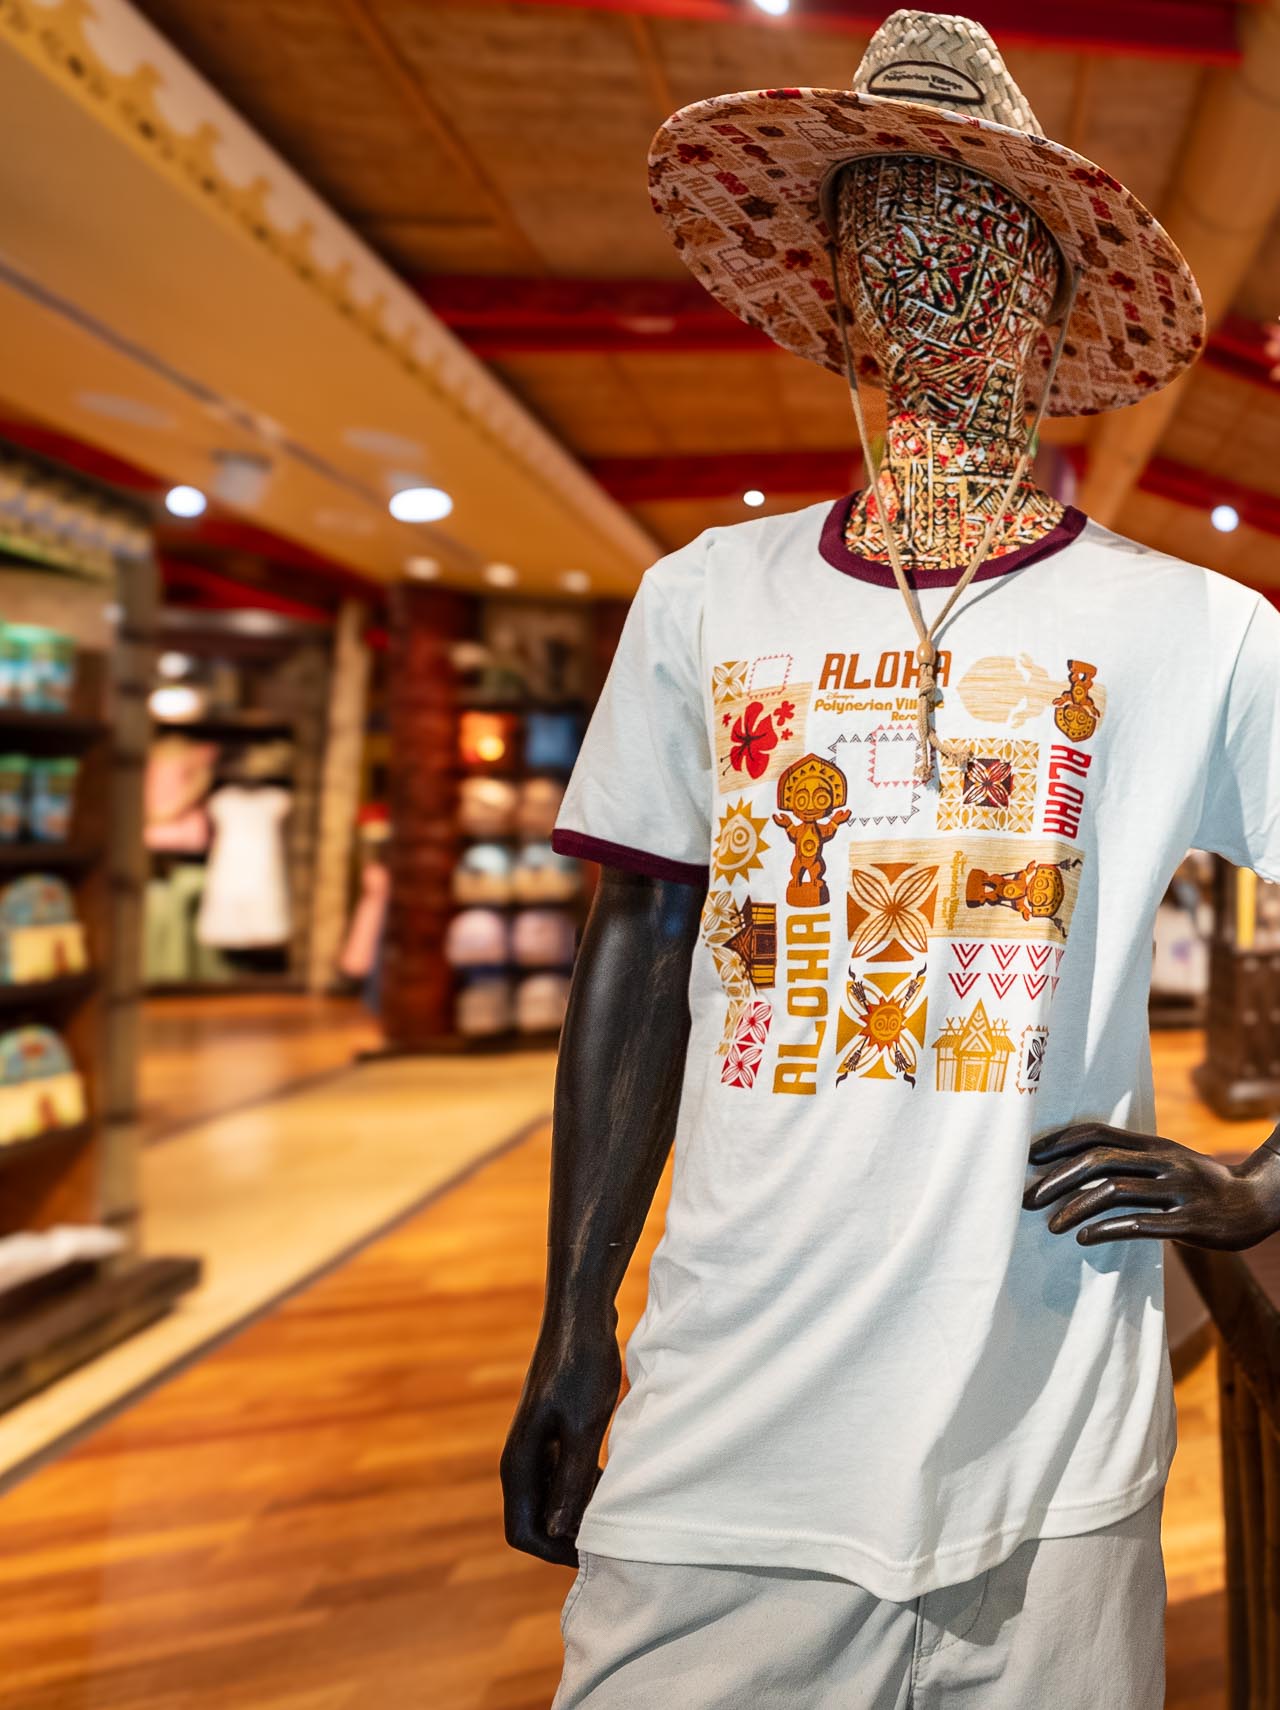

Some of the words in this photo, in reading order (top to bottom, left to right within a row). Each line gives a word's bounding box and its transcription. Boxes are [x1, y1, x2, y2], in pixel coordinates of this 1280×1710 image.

[818, 650, 952, 690] ALOHA
[814, 699, 893, 714] Polynesian
[896, 698, 945, 711] Ville
[891, 711, 919, 721] Reso
[1042, 744, 1093, 840] ALOHA
[772, 912, 831, 1096] ALOHA
